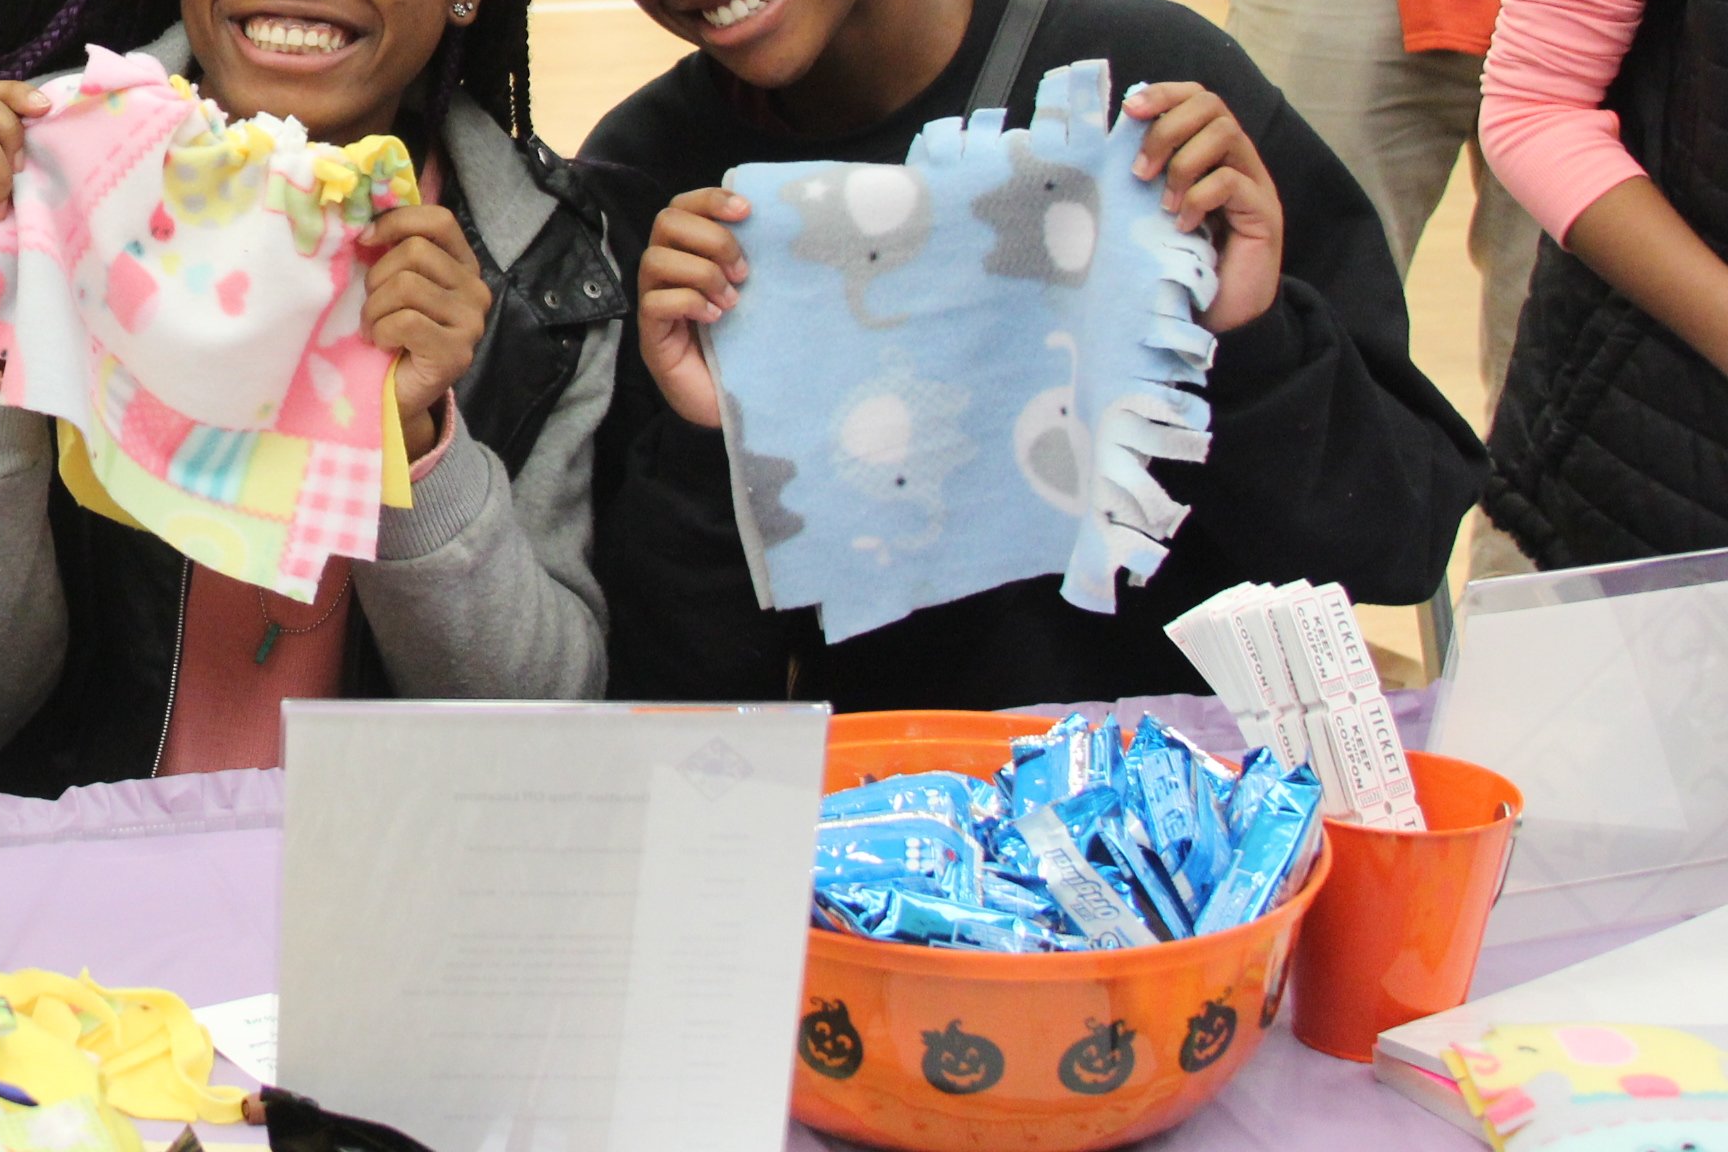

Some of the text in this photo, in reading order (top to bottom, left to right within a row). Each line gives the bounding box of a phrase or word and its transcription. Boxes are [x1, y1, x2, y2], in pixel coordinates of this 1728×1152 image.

[1235, 616, 1268, 687] COUPON
[1297, 607, 1328, 679] COUPON
[1313, 616, 1334, 662] KEEP
[1330, 599, 1364, 668] TICKET
[1278, 723, 1297, 766] COU
[1335, 716, 1364, 790] COUPON
[1352, 725, 1372, 771] KEEP
[1369, 707, 1401, 776] TICKET
[1044, 847, 1121, 922] Original
